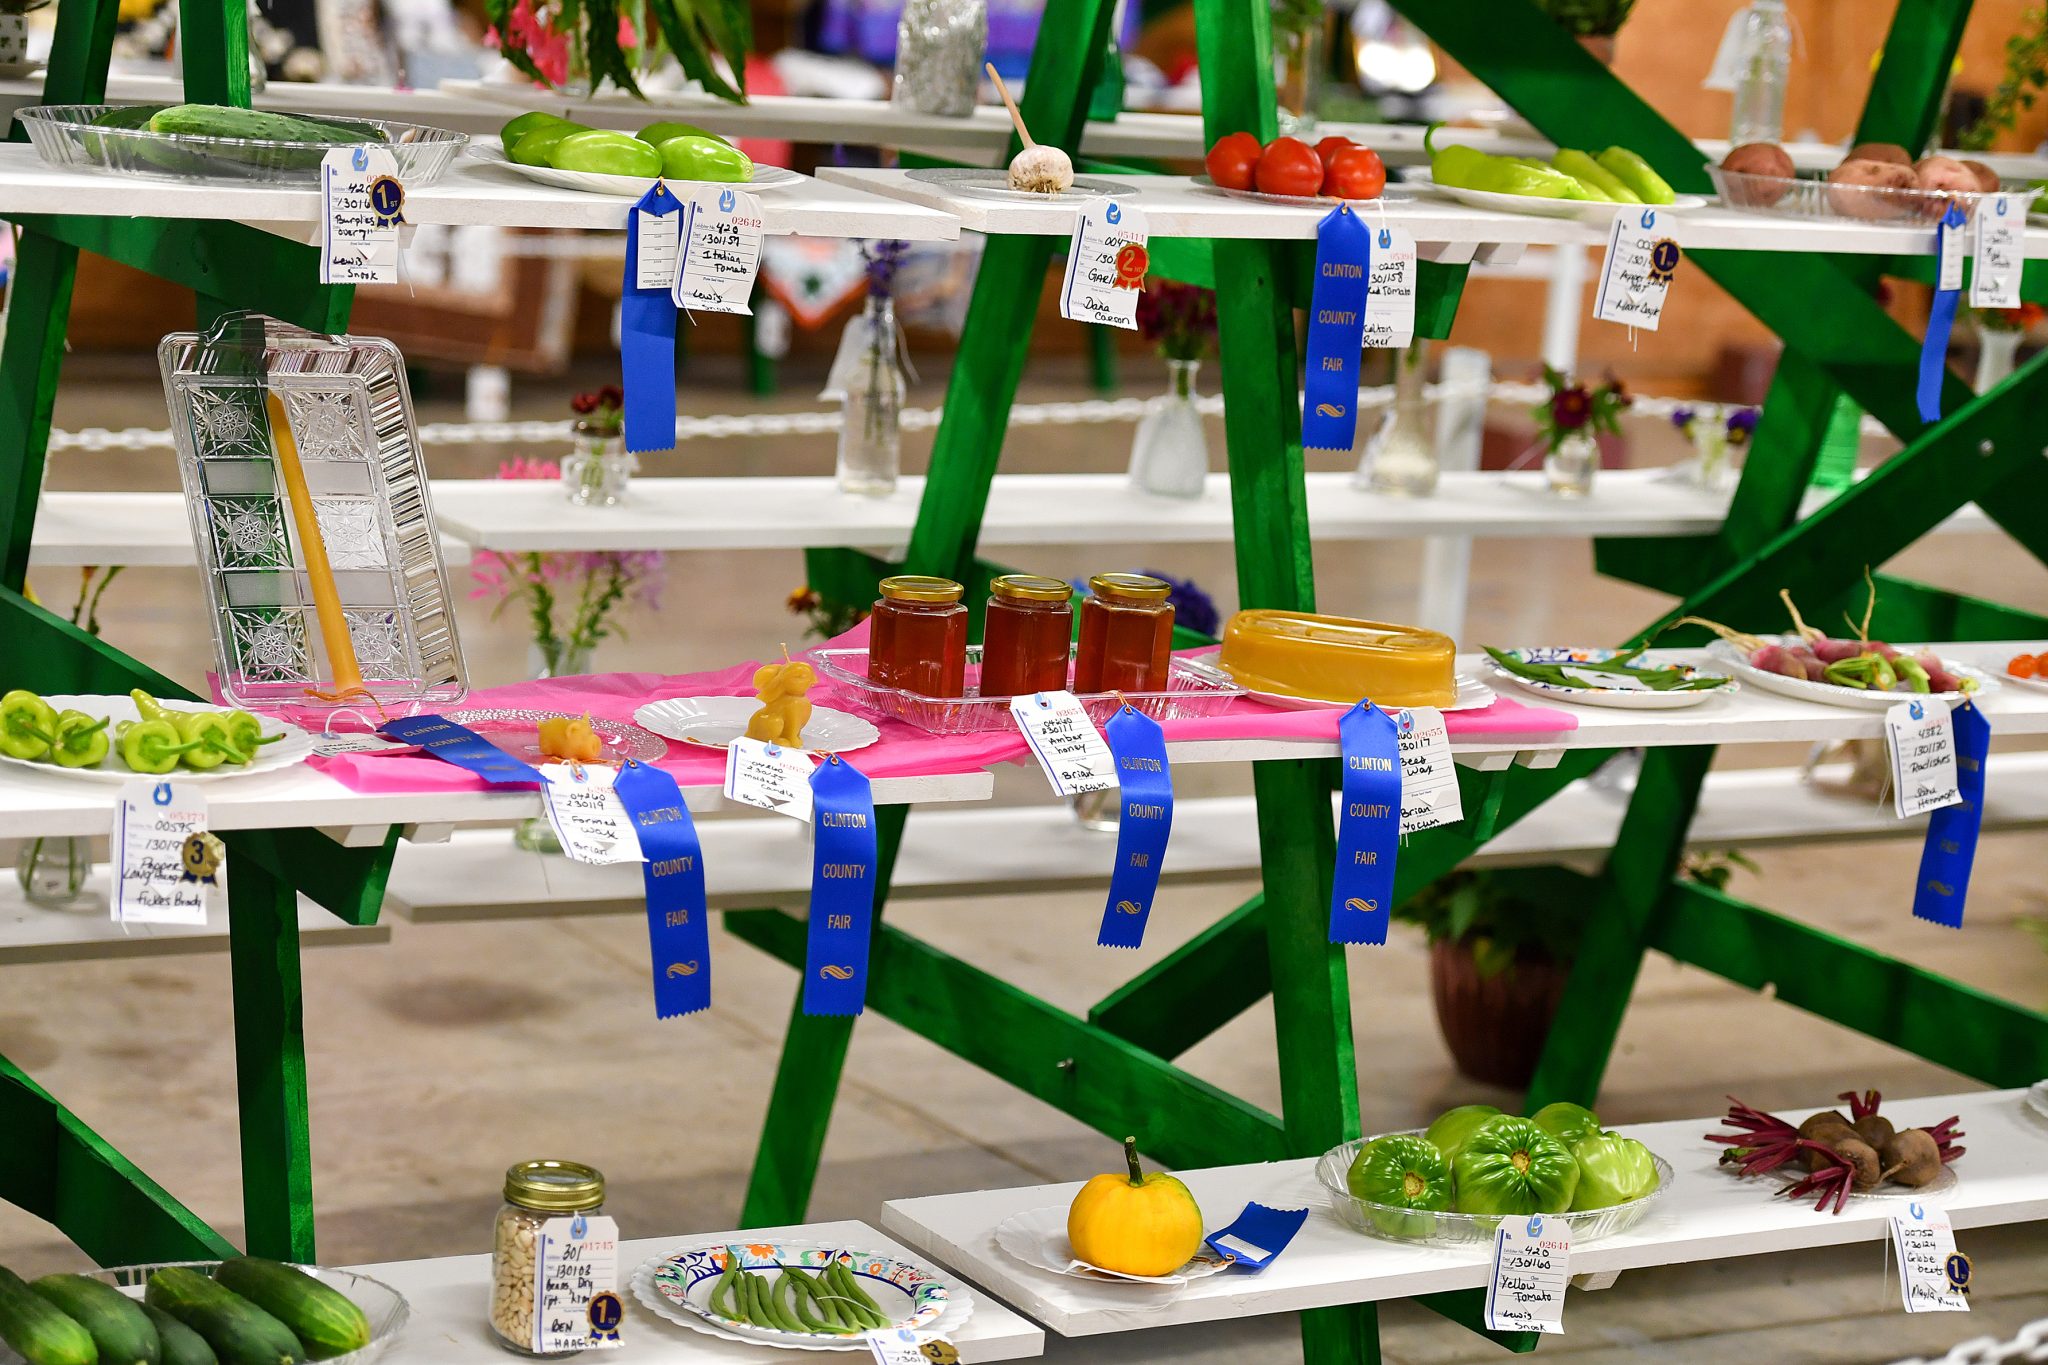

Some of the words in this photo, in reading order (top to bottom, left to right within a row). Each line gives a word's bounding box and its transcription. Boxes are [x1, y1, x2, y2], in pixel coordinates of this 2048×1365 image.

[716, 223, 738, 234] 420
[732, 216, 761, 227] 02642
[1322, 263, 1362, 278] CLINTON
[1319, 310, 1356, 325] COUNTY
[1322, 357, 1343, 371] FAIR
[403, 724, 451, 737] CLINTON
[1414, 728, 1442, 741] 02655
[1121, 756, 1162, 773] CLINTON
[1350, 756, 1392, 772] CLINTON
[637, 806, 682, 826] CLINTON
[1129, 802, 1164, 820] COUNTY
[1350, 803, 1390, 819] COUNTY
[823, 812, 866, 828] CLINTON
[1130, 852, 1149, 867] FAIR
[1355, 851, 1376, 865] FAIR
[653, 856, 693, 877] COUNTY
[822, 864, 865, 879] COUNTY
[666, 909, 688, 928] FAIR
[828, 915, 851, 929] FAIR
[1525, 1246, 1549, 1257] 420
